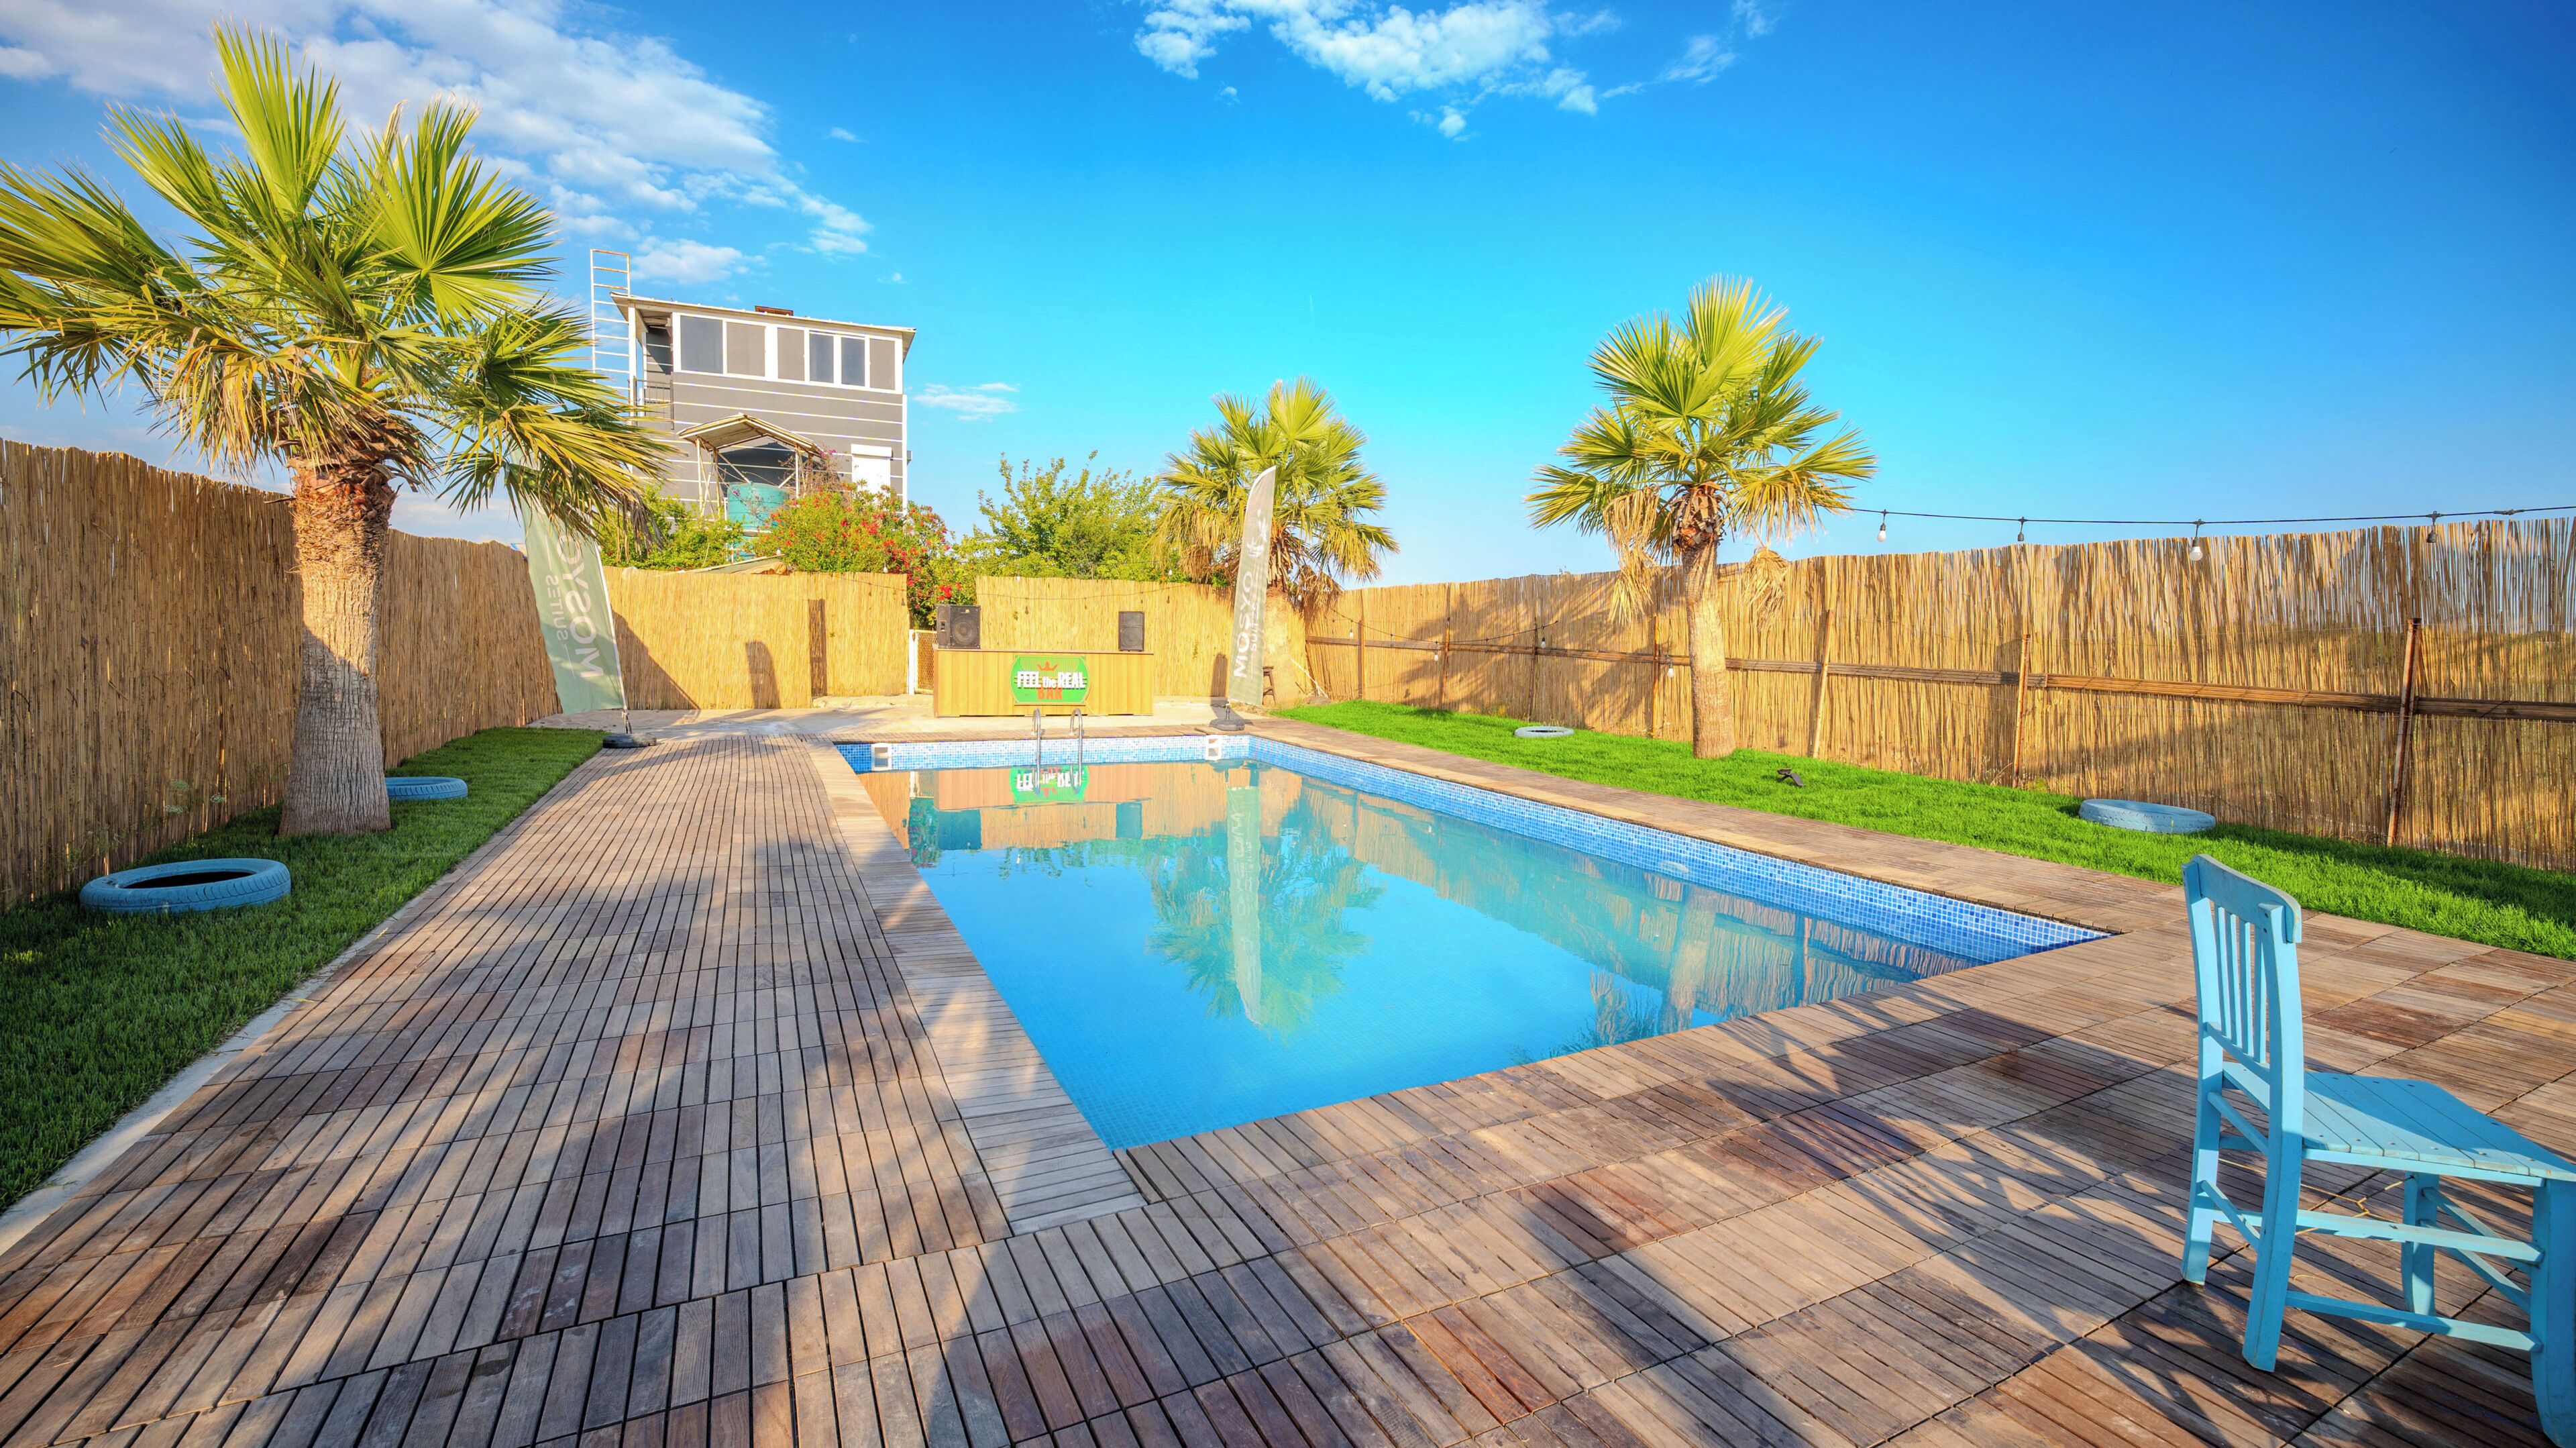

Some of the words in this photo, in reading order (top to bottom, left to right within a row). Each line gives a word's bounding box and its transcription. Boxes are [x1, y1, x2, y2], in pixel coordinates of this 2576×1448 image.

[1234, 571, 1253, 678] MOSYO
[1250, 603, 1259, 652] SUITES
[1017, 670, 1041, 688] FEEL
[1042, 676, 1057, 688] the
[1057, 672, 1085, 688] REAL
[1037, 686, 1063, 700] BAR
